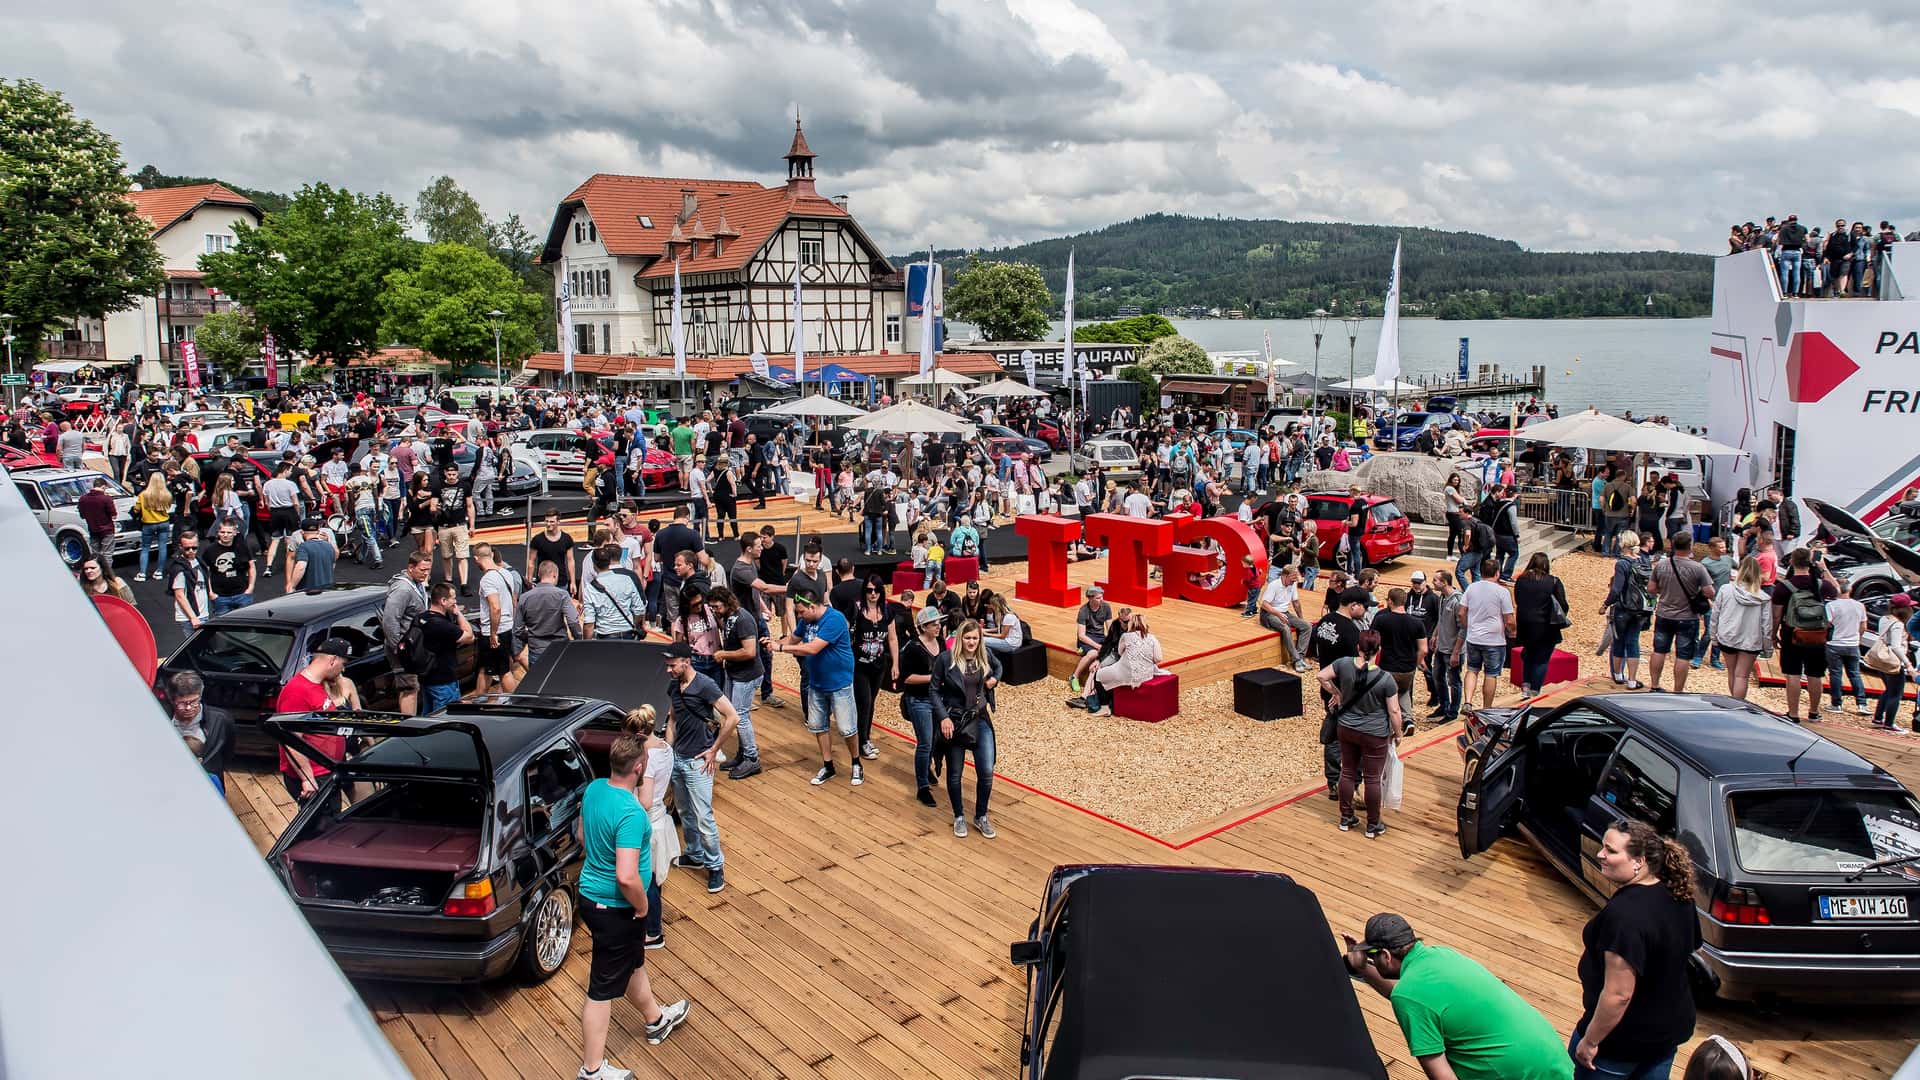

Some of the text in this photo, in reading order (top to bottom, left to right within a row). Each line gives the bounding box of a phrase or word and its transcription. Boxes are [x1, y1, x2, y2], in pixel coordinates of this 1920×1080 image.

[1875, 331, 1920, 354] PA
[1862, 390, 1920, 414] FRI
[1831, 899, 1906, 915] ME VW 160
